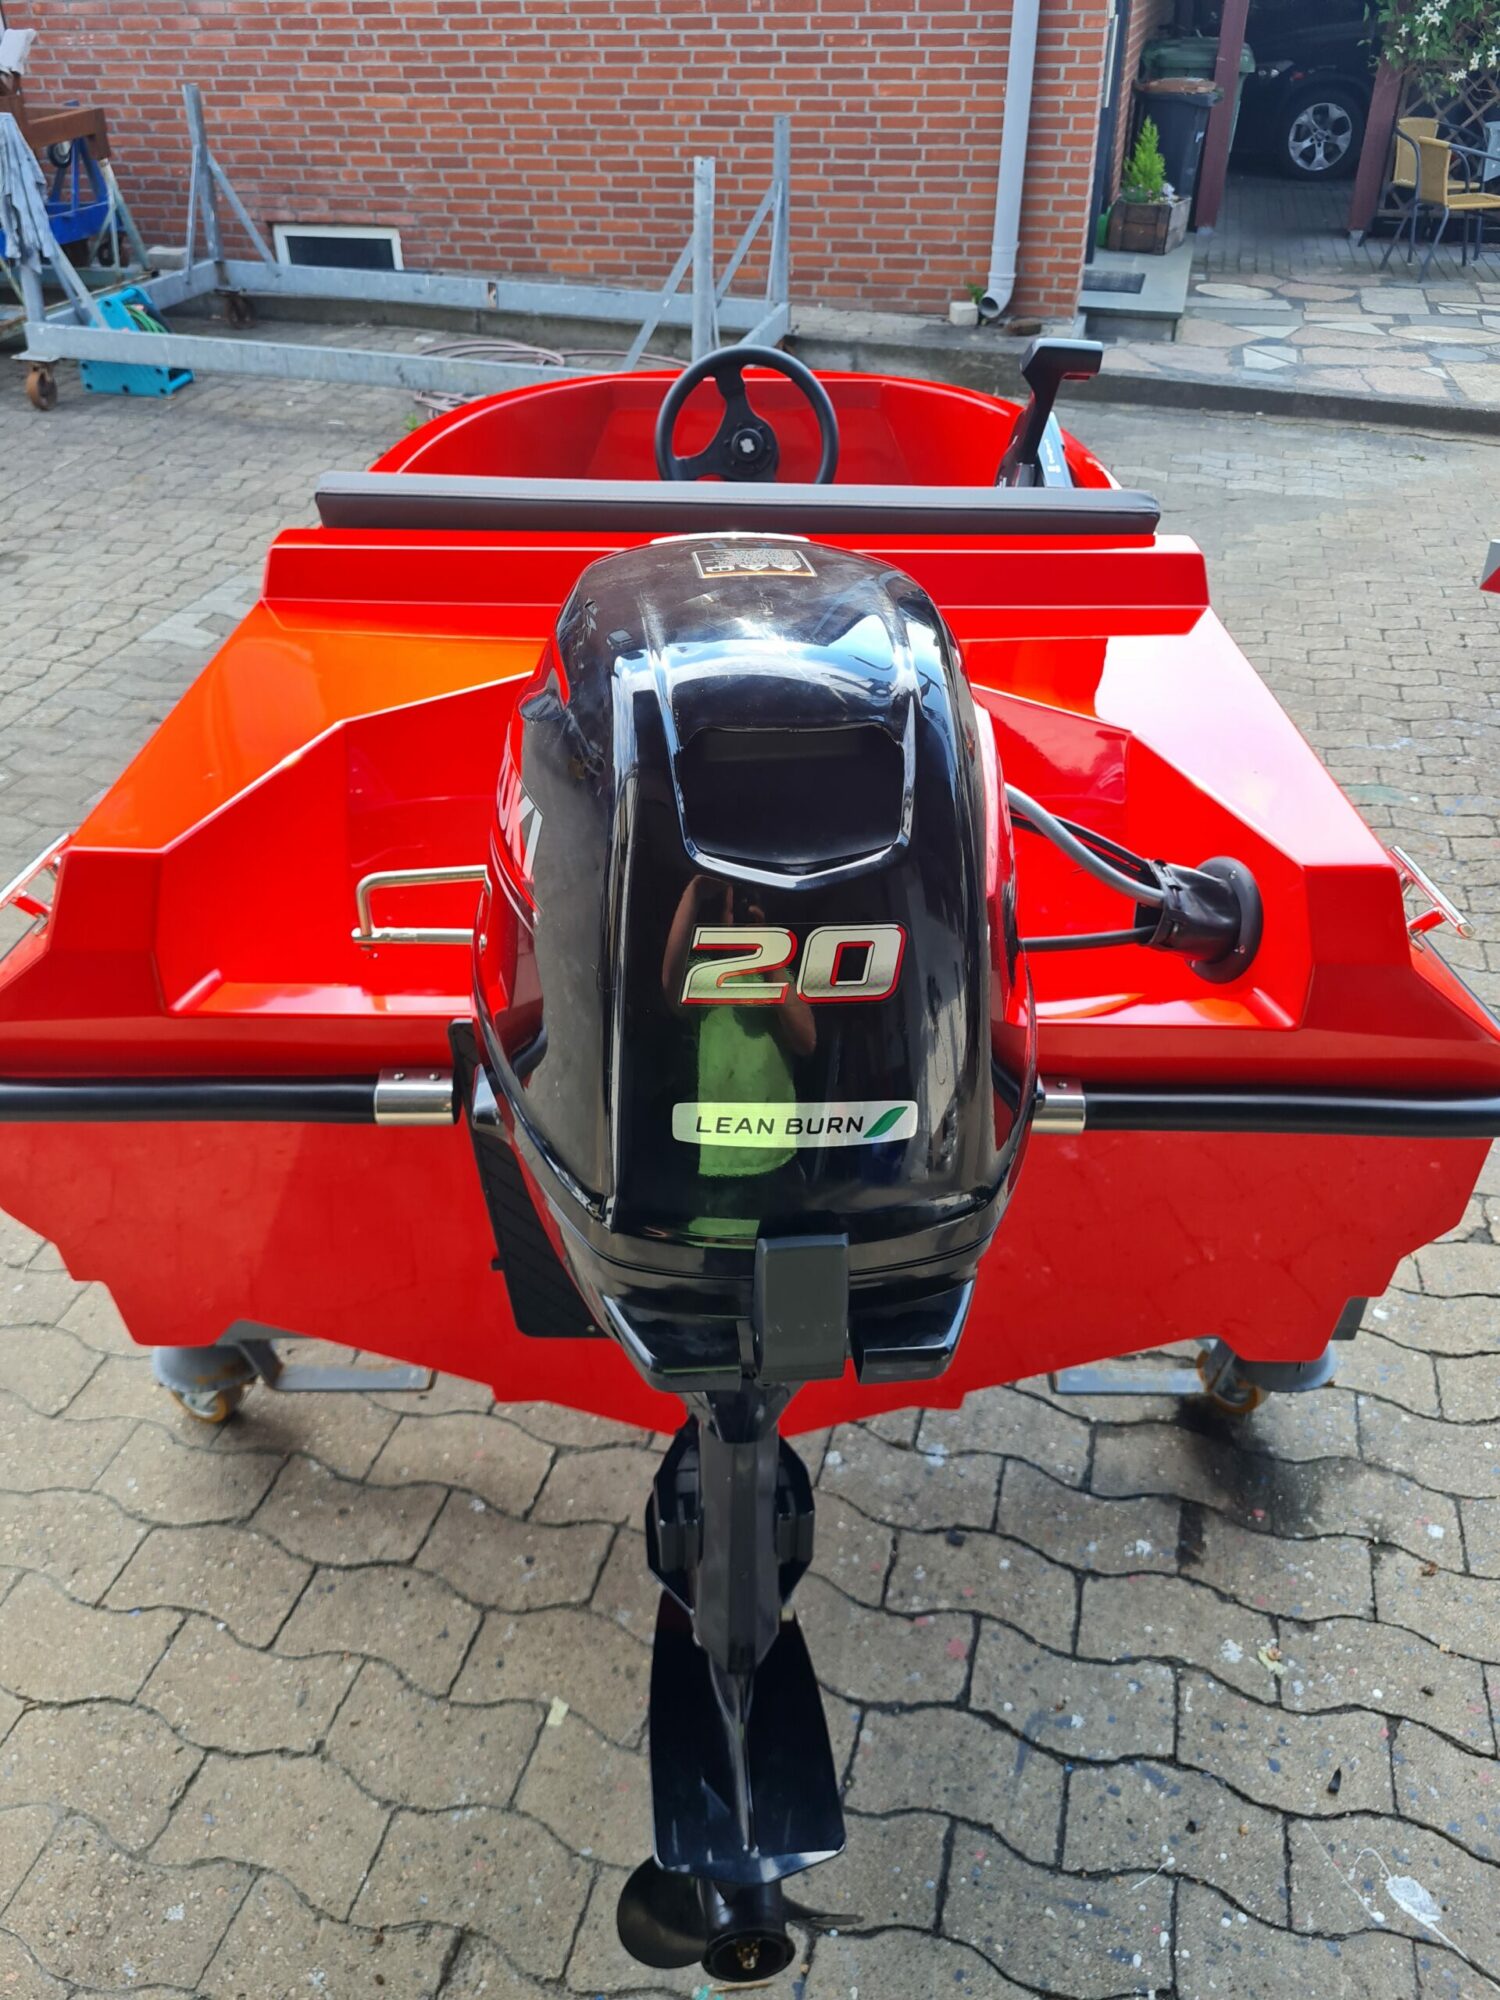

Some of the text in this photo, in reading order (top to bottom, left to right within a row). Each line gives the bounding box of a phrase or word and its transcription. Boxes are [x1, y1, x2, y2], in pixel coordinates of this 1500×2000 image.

[497, 738, 543, 880] UKI
[681, 924, 907, 1004] 20
[696, 1115, 864, 1135] LEAN BURN
